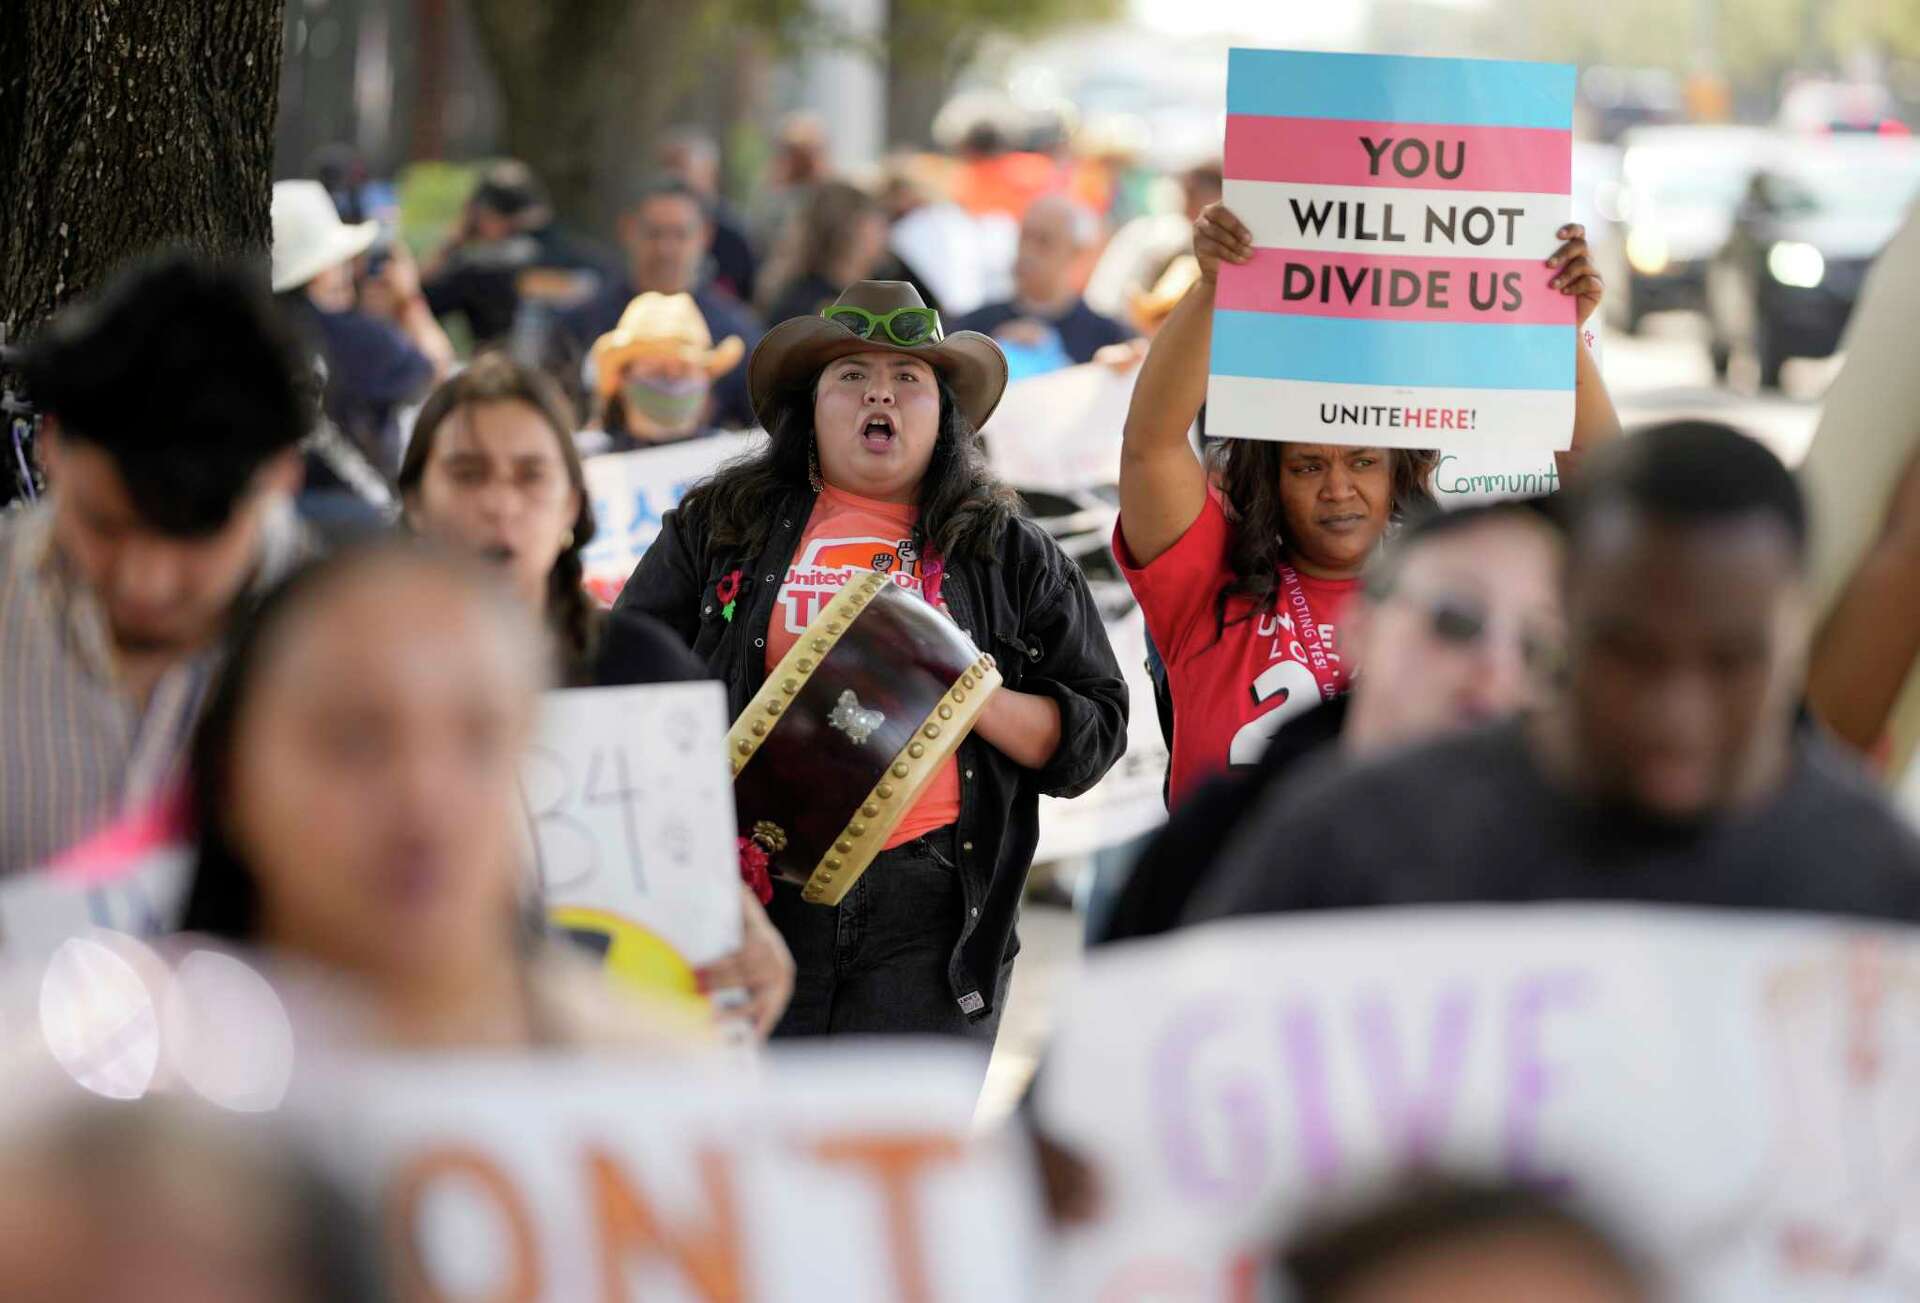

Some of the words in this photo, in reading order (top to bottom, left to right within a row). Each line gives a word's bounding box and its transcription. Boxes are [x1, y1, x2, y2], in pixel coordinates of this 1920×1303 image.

[1358, 136, 1466, 180] YOU
[1288, 198, 1406, 242] WILL
[1424, 205, 1525, 246] NOT
[1281, 261, 1450, 309] DIVIDE
[1468, 271, 1523, 312] US
[1319, 402, 1477, 430] UNITEHERE!
[1436, 455, 1559, 495] Communit
[784, 568, 852, 587] United
[1290, 587, 1318, 639] VOTING
[1309, 641, 1329, 670] YES!
[1150, 968, 1592, 1205] GIVE
